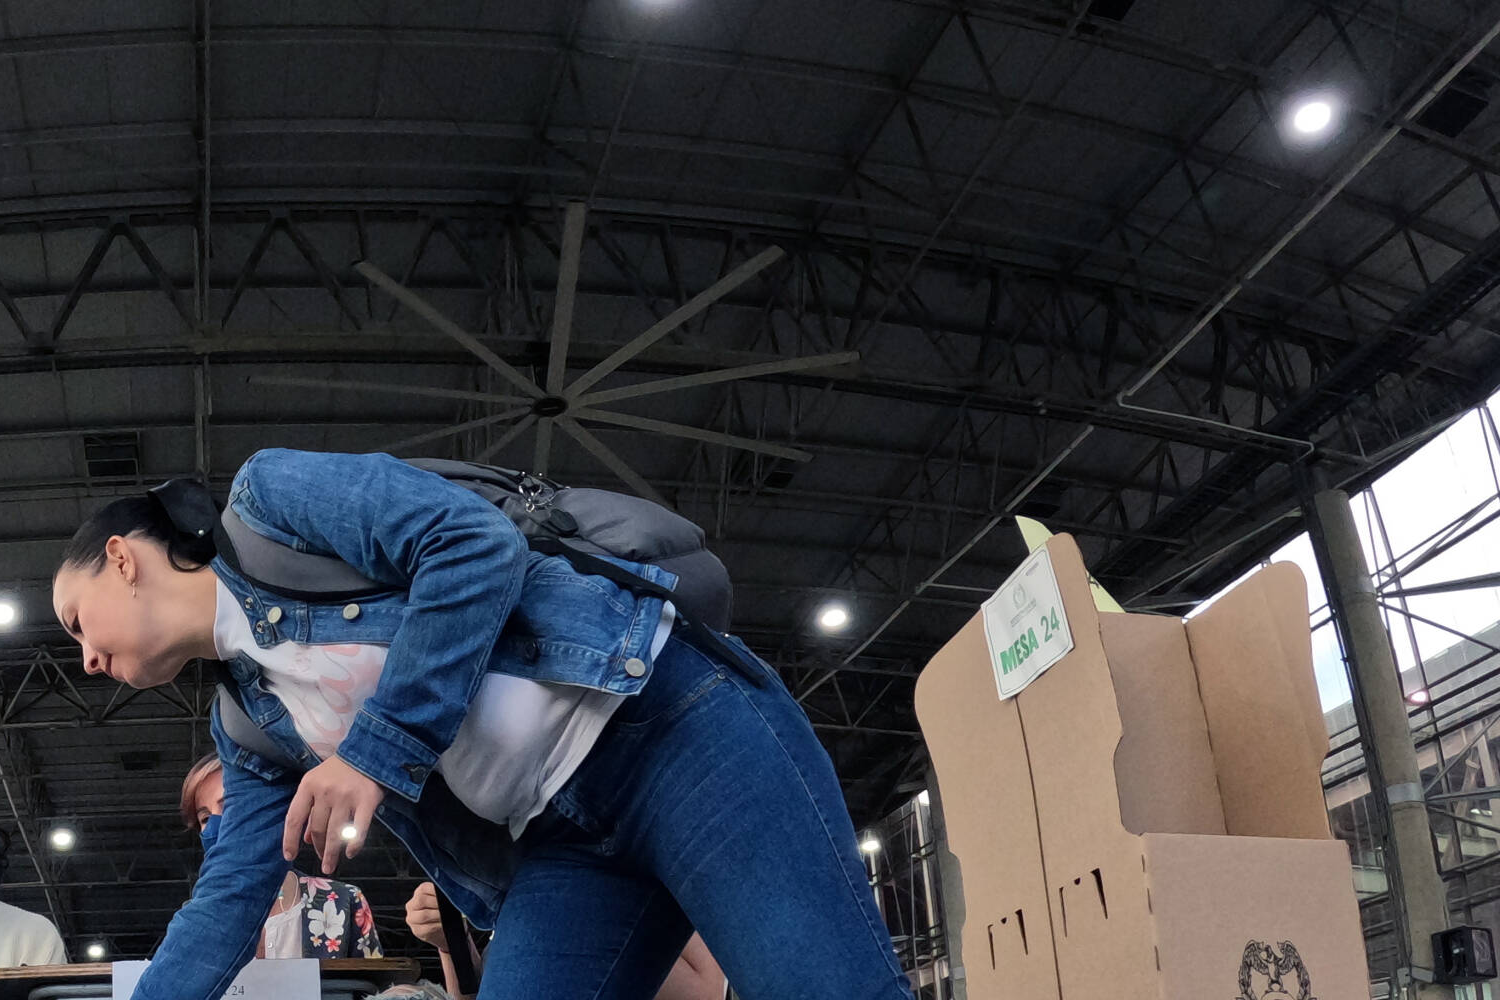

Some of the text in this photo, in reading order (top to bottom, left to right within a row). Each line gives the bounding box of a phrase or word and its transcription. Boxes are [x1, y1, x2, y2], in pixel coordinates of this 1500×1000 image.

[1000, 627, 1039, 675] MESA
[1041, 606, 1060, 643] 24
[231, 985, 245, 996] 24
